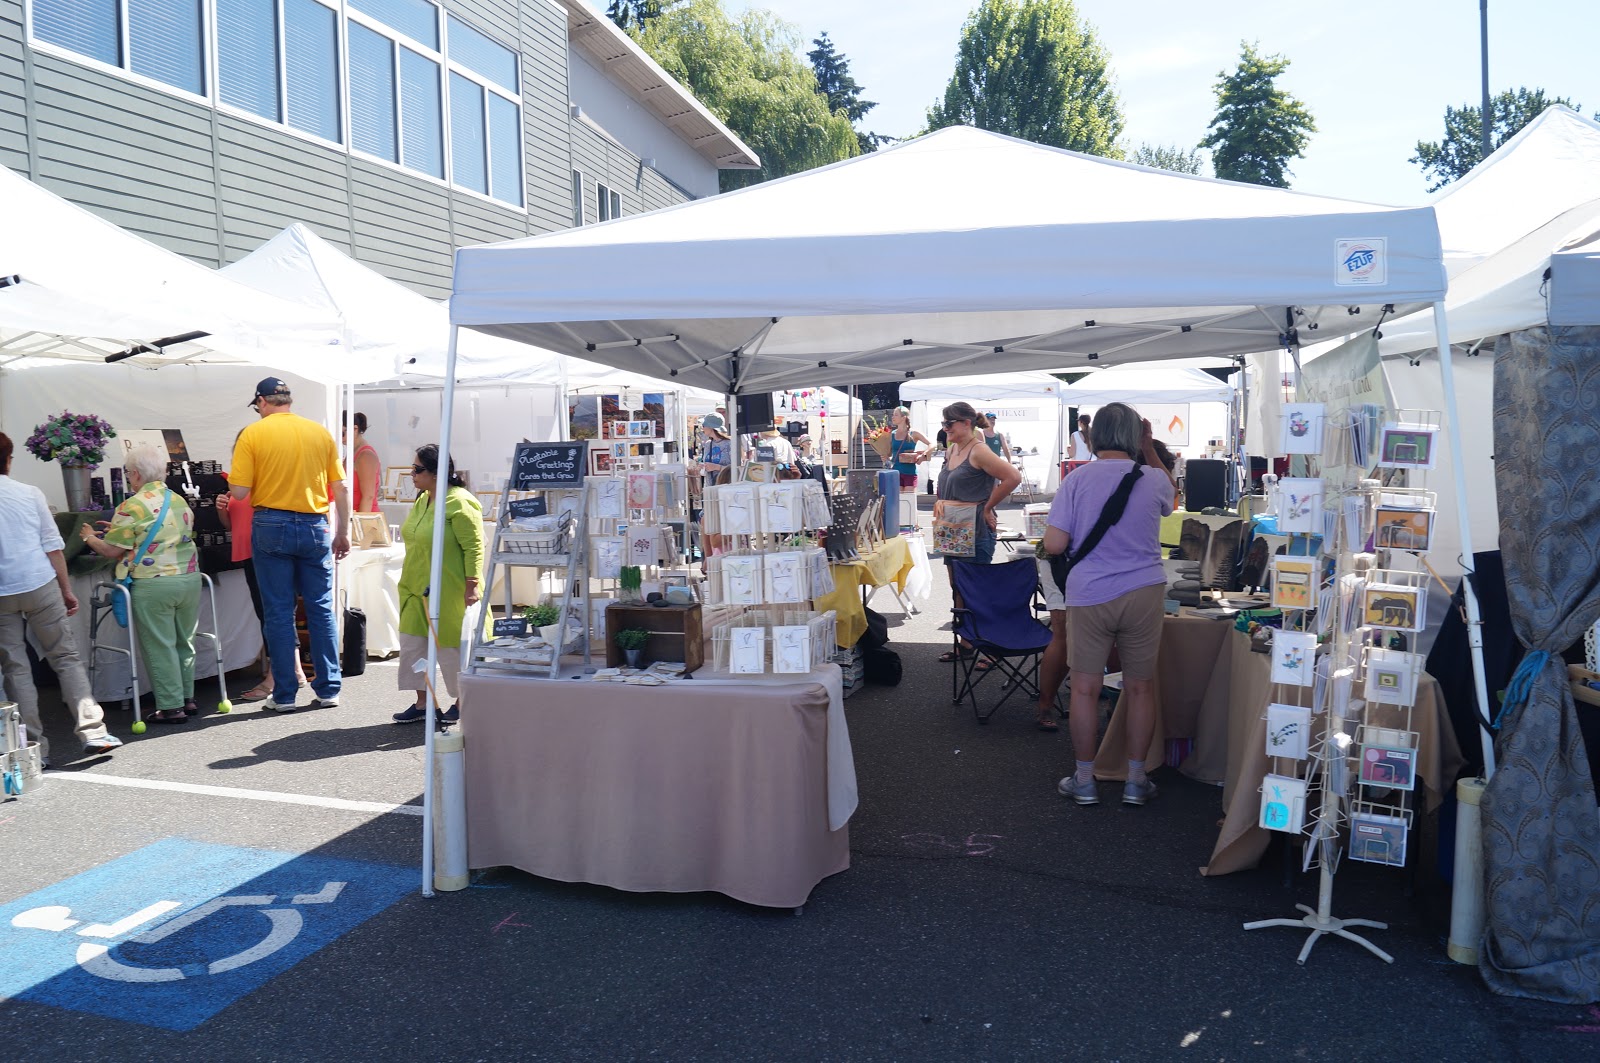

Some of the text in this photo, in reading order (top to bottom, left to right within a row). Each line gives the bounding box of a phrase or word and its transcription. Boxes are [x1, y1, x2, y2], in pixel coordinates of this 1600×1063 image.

[519, 449, 559, 466] Plantable
[536, 460, 575, 472] Greetings
[519, 472, 540, 480] Cards
[556, 472, 575, 480] Grow
